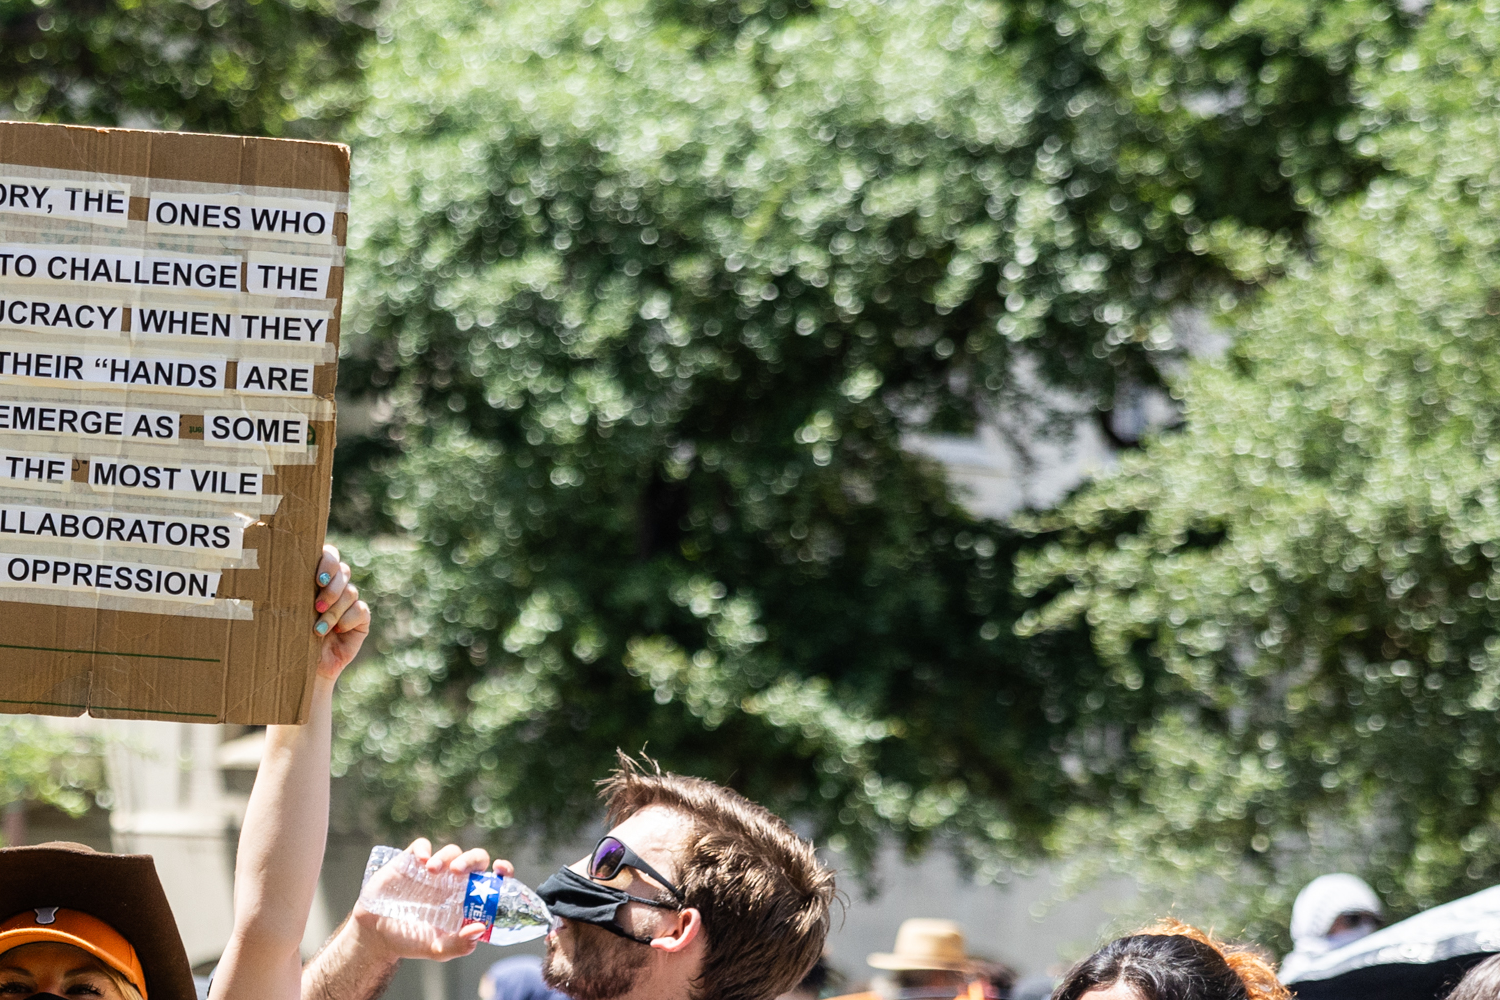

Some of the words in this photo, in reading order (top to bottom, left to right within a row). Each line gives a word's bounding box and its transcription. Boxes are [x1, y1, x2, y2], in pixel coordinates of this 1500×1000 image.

[64, 186, 126, 215] THE
[156, 202, 241, 229] ONES
[251, 208, 326, 234] WHO
[47, 256, 237, 289] CHALLENGE
[257, 265, 318, 292] THE
[139, 308, 231, 337] WHEN
[241, 314, 324, 342] THEY
[243, 366, 309, 392] ARE
[132, 414, 173, 439] AS
[211, 415, 301, 444] SOME
[5, 454, 67, 482] THE
[94, 463, 181, 490] MOST
[190, 469, 257, 495] VILE
[7, 557, 216, 598] OPPRESSION.
